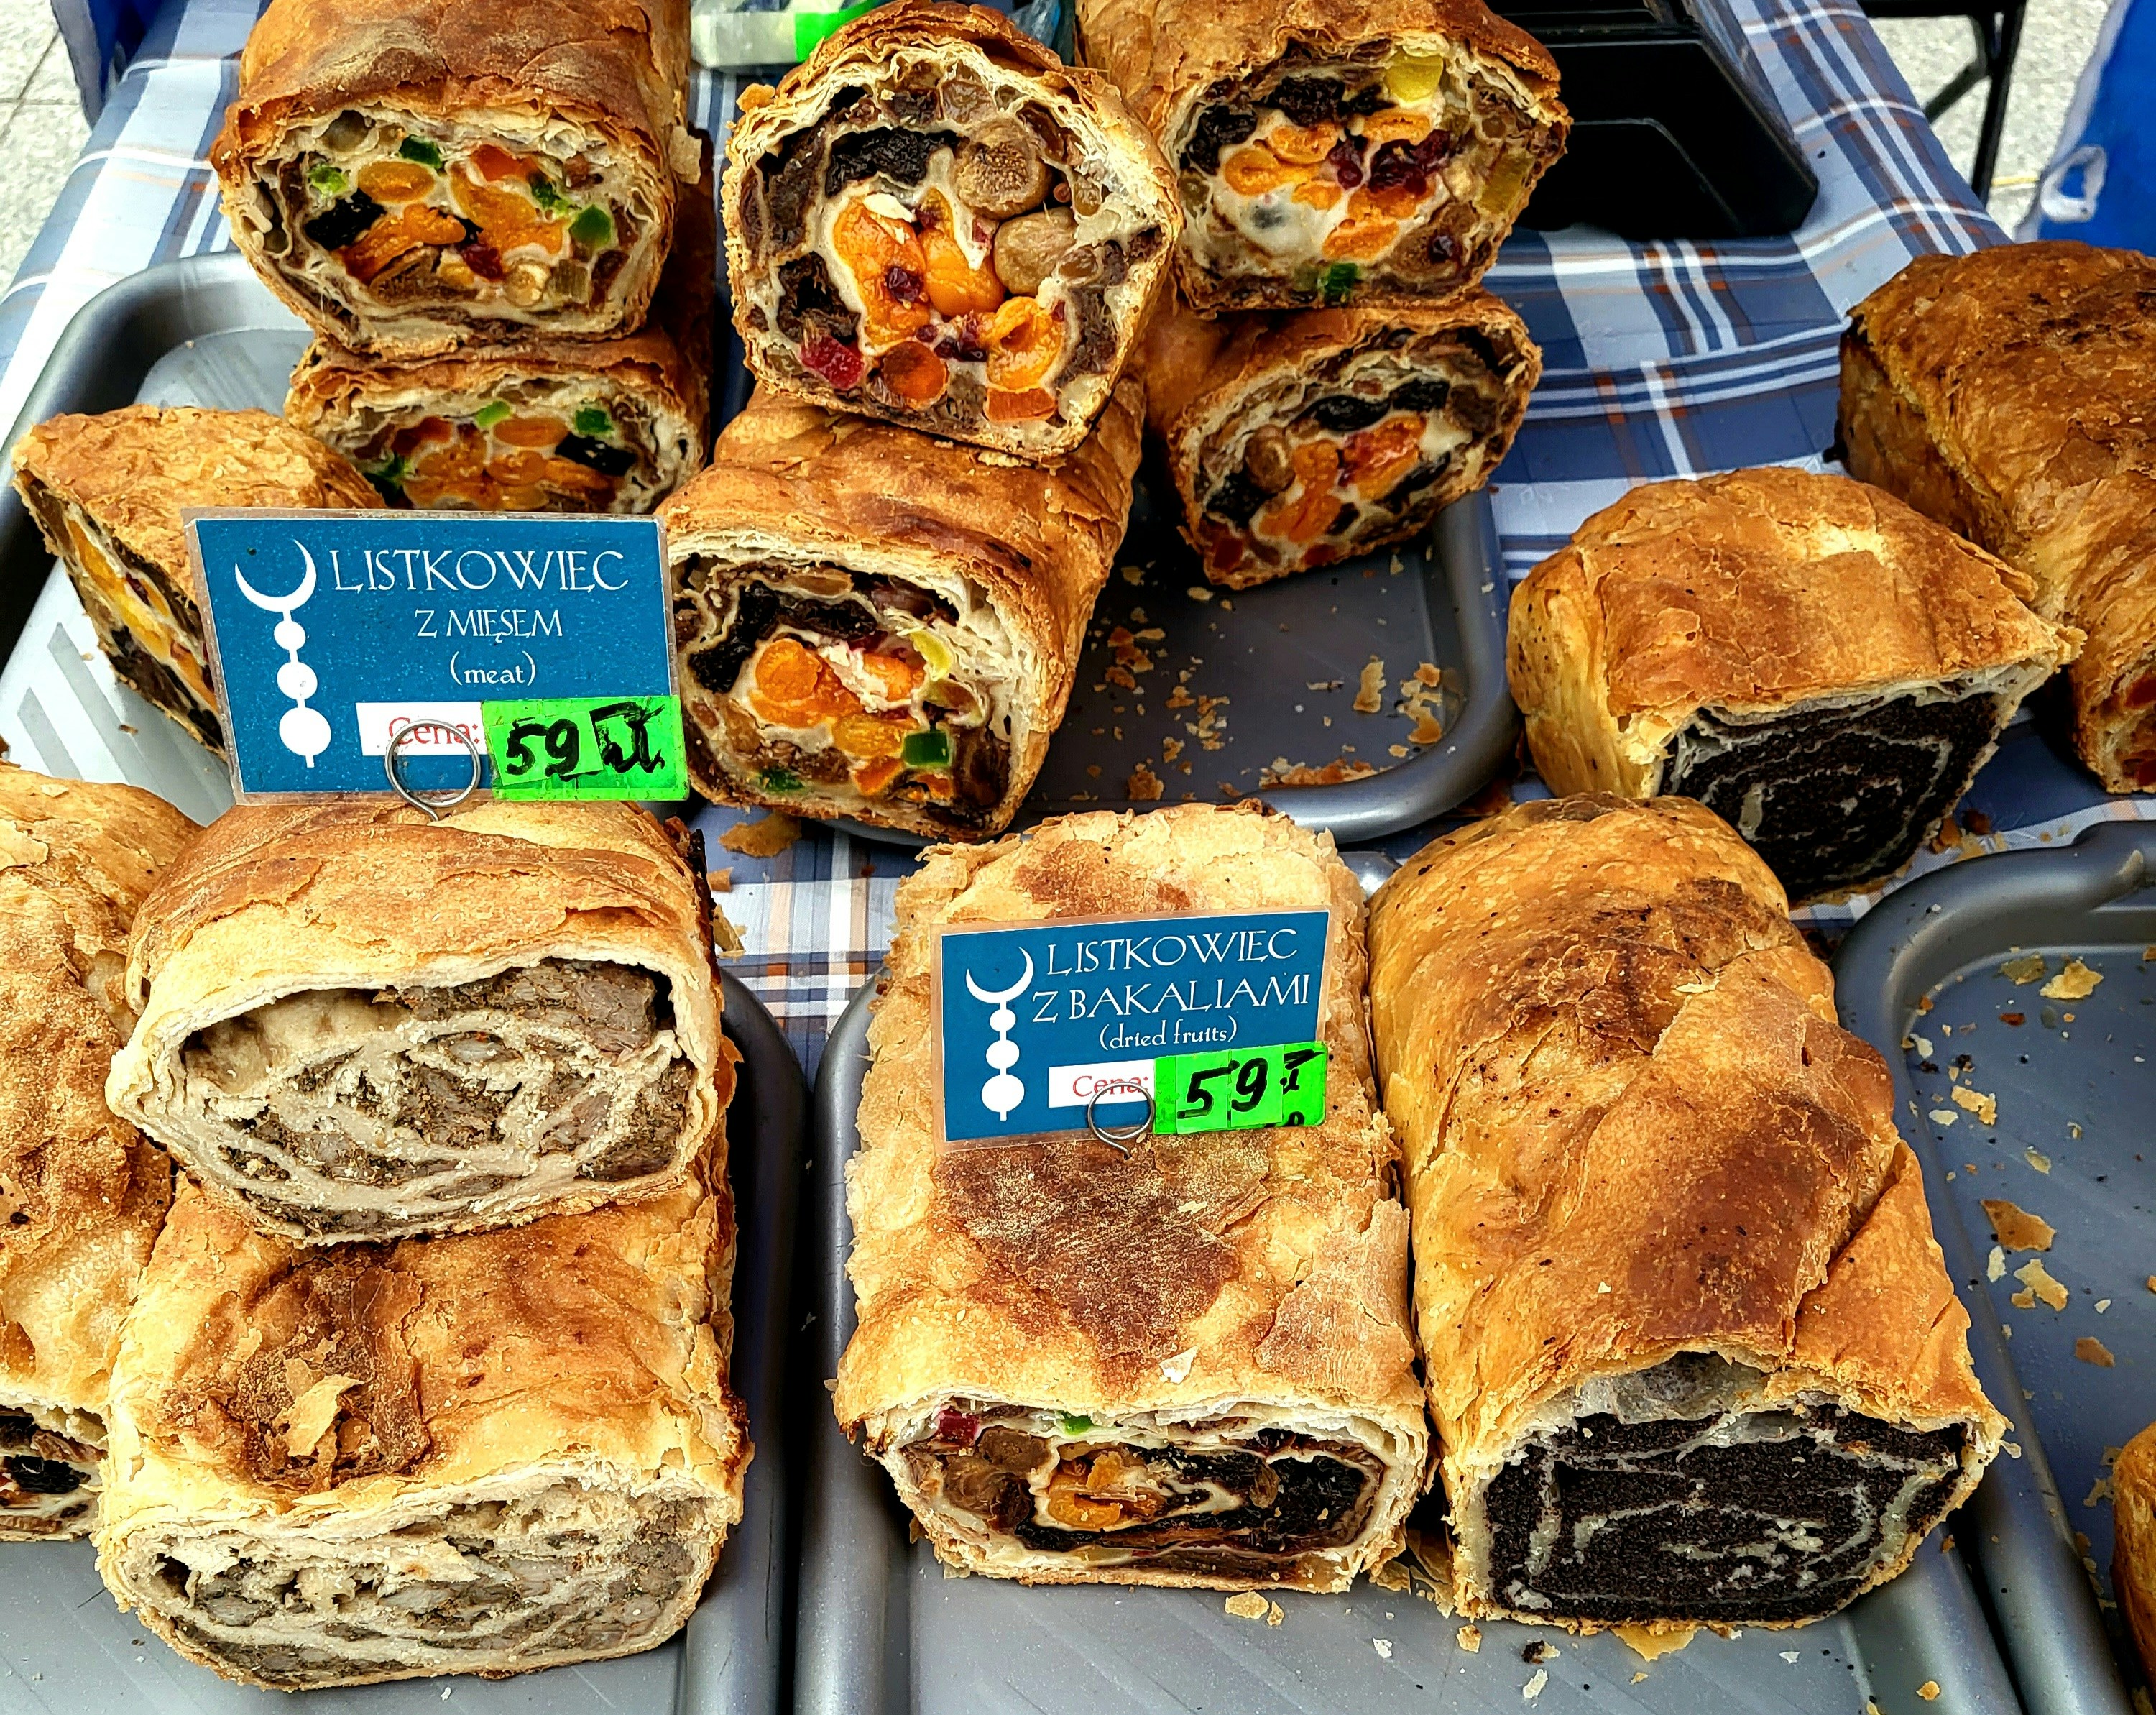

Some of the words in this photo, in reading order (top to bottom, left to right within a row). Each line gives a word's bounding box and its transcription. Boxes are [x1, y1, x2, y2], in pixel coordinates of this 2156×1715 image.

[329, 549, 630, 592] LISTKOWIEC
[414, 609, 438, 638] Z
[446, 608, 563, 644] MIĘSEM
[449, 650, 536, 686] (meat)
[389, 717, 480, 745] Cena:
[507, 717, 580, 781] 59
[1046, 929, 1297, 977] LISTKOWIEC
[1031, 990, 1059, 1024] Z
[1068, 973, 1311, 1020] BAKALIAMI
[1100, 1019, 1166, 1051] (dried
[1174, 1015, 1238, 1044] fruits)
[1072, 1075, 1149, 1098] Cena:
[1177, 1057, 1268, 1119] 59
